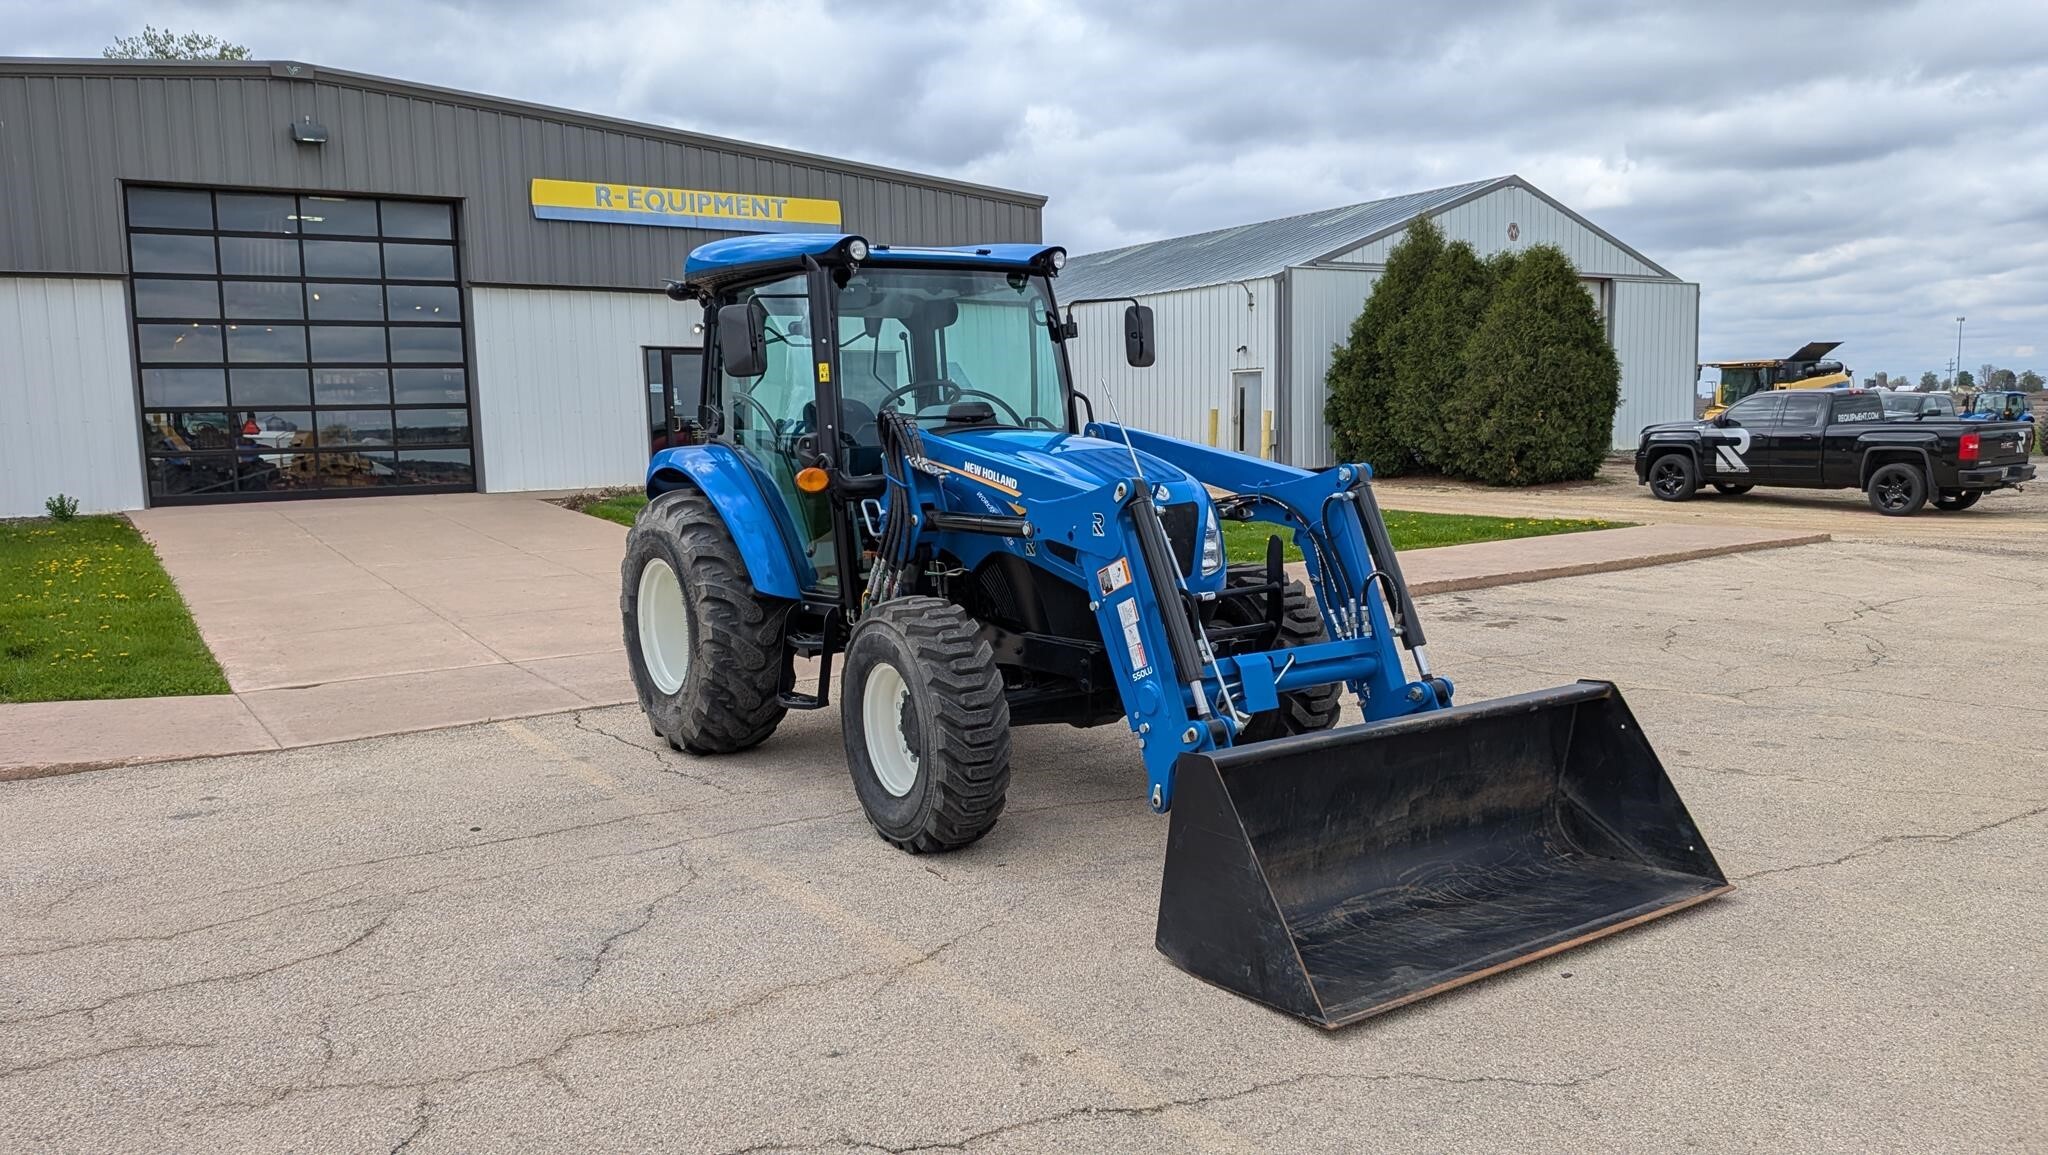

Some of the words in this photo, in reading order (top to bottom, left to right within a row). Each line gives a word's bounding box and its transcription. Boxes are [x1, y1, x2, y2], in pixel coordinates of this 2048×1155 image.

[595, 185, 787, 219] R-EQUIPMENT
[964, 461, 982, 476] NEW
[982, 467, 1018, 490] HOLLAND
[1132, 666, 1153, 682] 550LU
